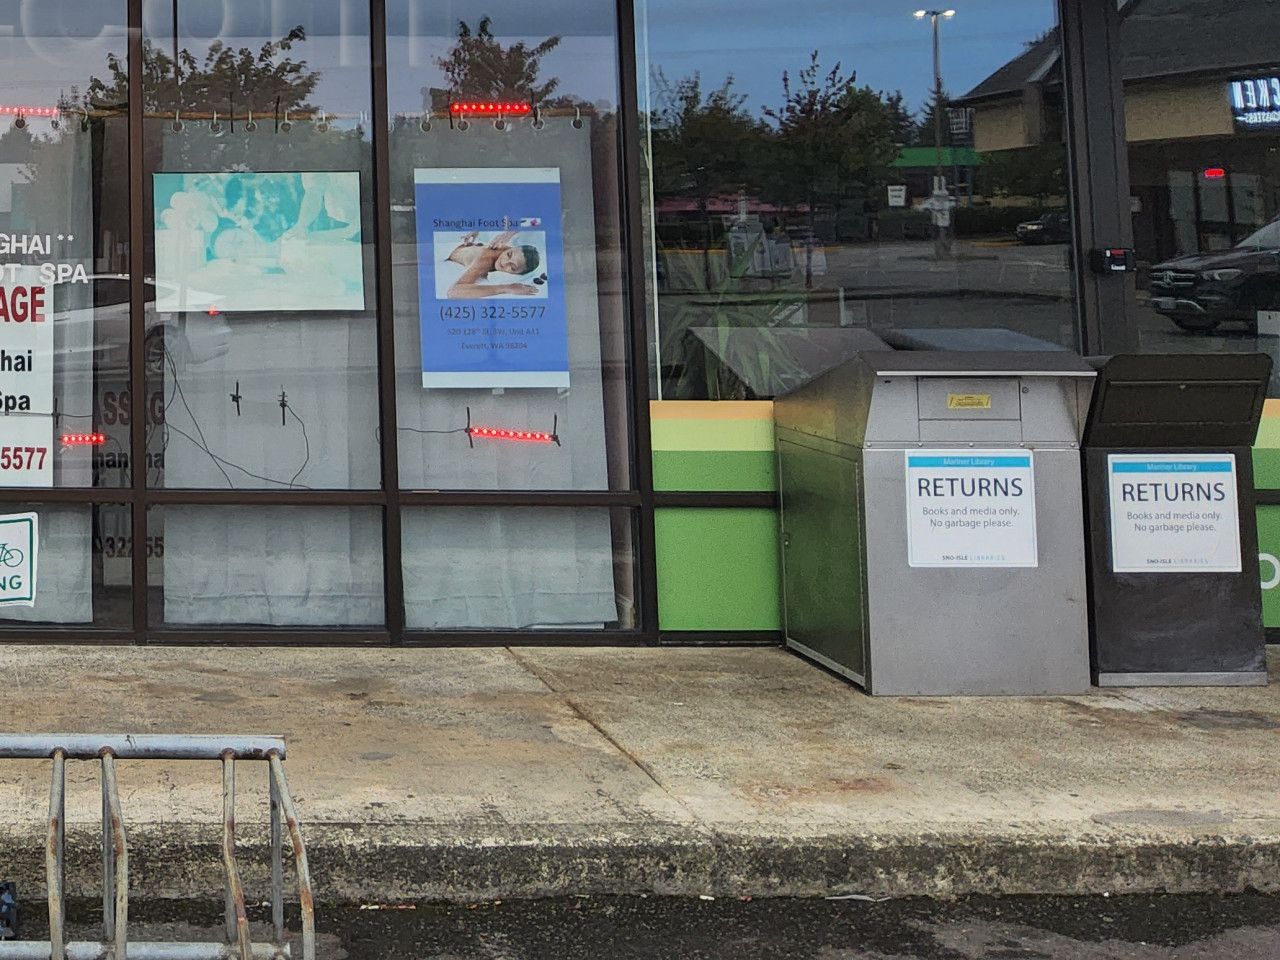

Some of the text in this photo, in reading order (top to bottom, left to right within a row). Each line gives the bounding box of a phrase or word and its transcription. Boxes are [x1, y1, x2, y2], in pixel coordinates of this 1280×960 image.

[433, 219, 475, 229] Shanghai
[478, 218, 499, 227] Foot
[39, 263, 89, 284] SPA
[440, 306, 546, 321] (425) 322-5577
[1, 447, 47, 470] 5577
[918, 478, 1023, 497] RETURNS
[1122, 483, 1226, 501] RETURNS
[922, 507, 1020, 517] Books and media only.
[1127, 512, 1153, 520] Books
[1201, 511, 1222, 521] only.
[945, 520, 981, 529] garbage
[983, 520, 1014, 528] please.
[1134, 523, 1216, 533] No garbage please.
